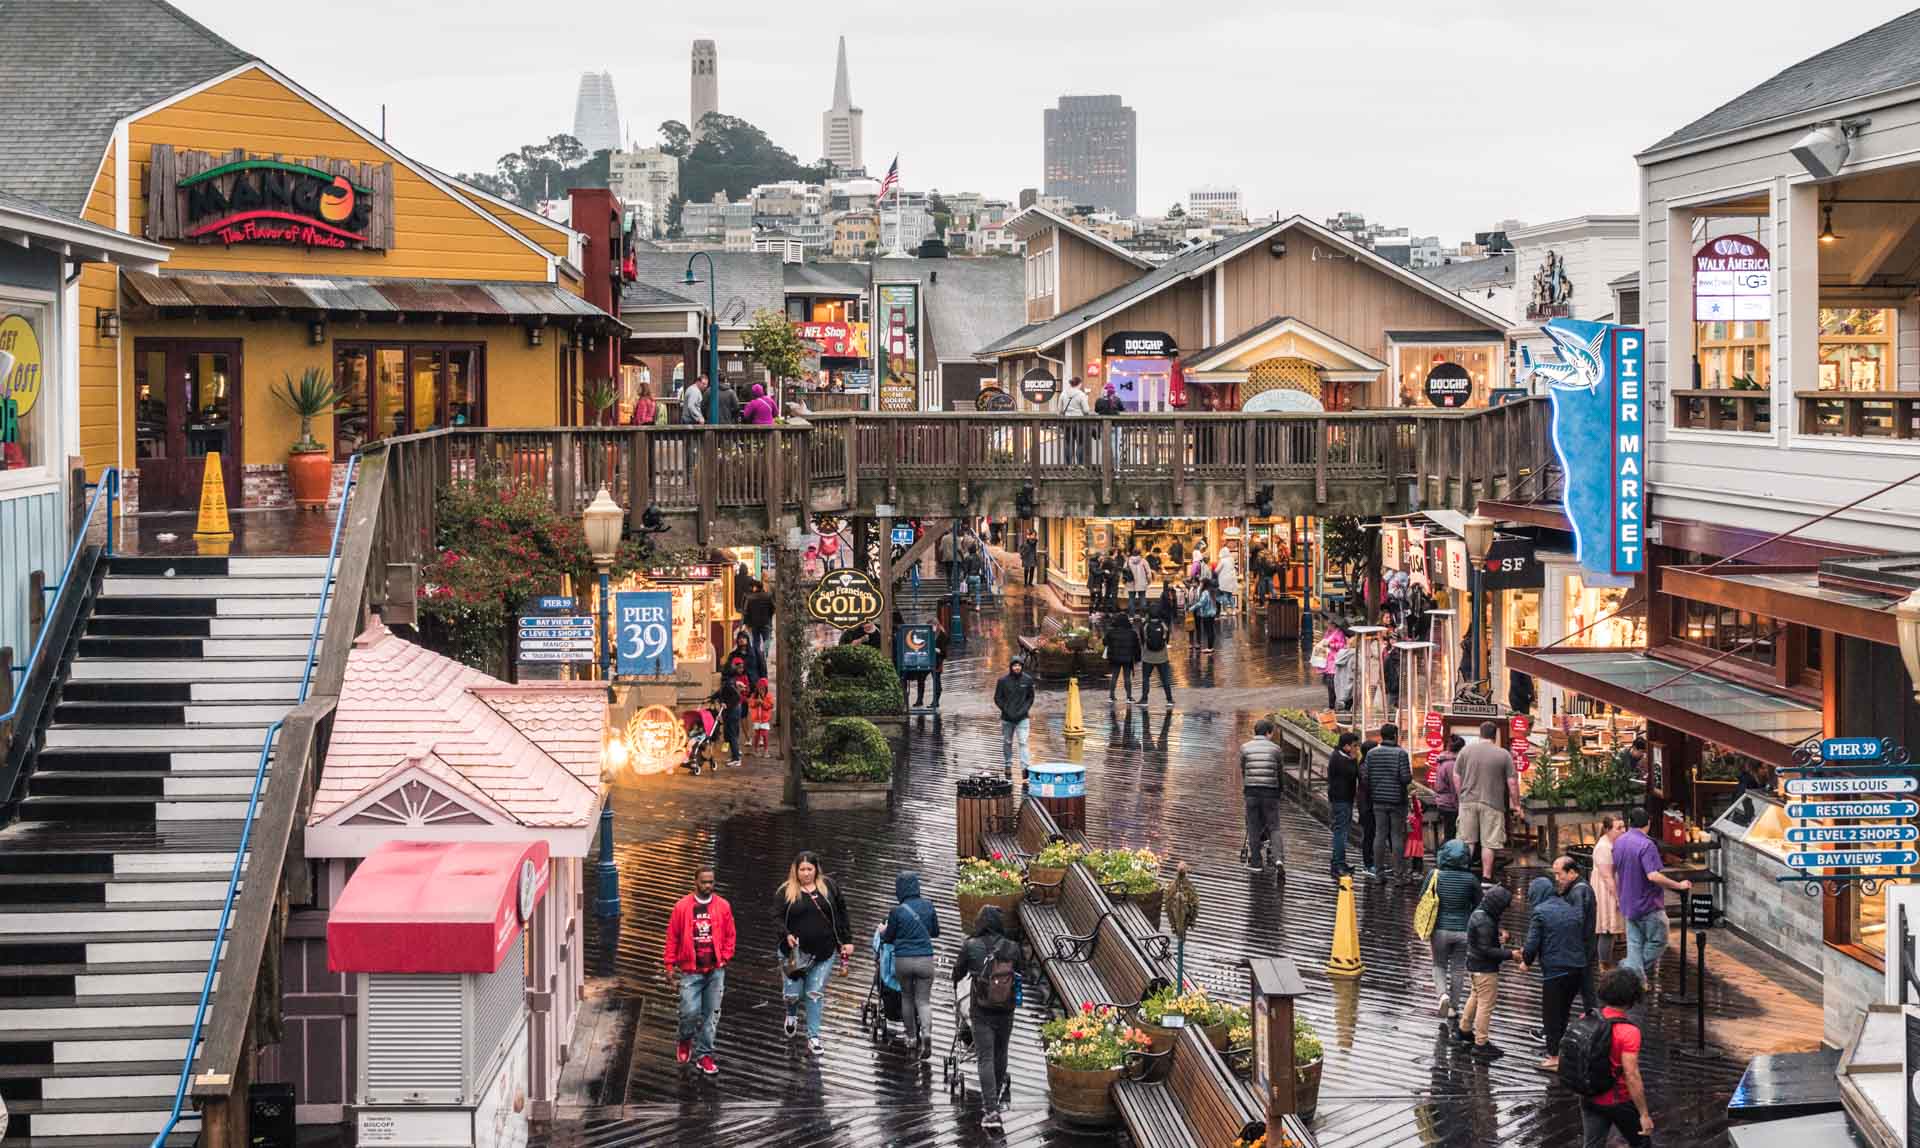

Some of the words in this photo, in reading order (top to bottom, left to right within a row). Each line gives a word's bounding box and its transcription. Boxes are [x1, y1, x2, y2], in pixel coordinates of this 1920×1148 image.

[219, 228, 245, 244] The
[244, 222, 283, 240] Flavor
[284, 225, 300, 241] of
[302, 226, 346, 249] Mexico
[1697, 257, 1726, 270] WALK
[1727, 257, 1769, 270] AMERICA
[804, 326, 823, 338] NFL
[824, 326, 846, 340] Shop
[1125, 339, 1164, 350] DOUGHP
[1430, 378, 1469, 389] DOUGHP
[1621, 338, 1639, 422] PIER
[1620, 434, 1640, 565] MARKET
[1502, 557, 1525, 571] SF
[820, 590, 835, 598] San
[836, 586, 872, 599] Francisco
[543, 599, 561, 607] PIER
[816, 596, 877, 614] GOLD
[623, 607, 665, 622] PIER
[623, 623, 668, 659] 39
[1454, 705, 1469, 714] PIER
[1469, 705, 1495, 714] MARKET
[1829, 743, 1861, 756] PIER
[1862, 743, 1877, 756] 39
[1811, 781, 1849, 792] SWISS
[1852, 780, 1888, 791] LOUIS
[1816, 804, 1891, 817] RESTROOMS
[1809, 829, 1847, 841] LEVEL
[1849, 830, 1857, 840] 2
[1859, 828, 1900, 840] SHOPS
[1817, 854, 1841, 865] BAY
[1843, 853, 1882, 864] VIEWS
